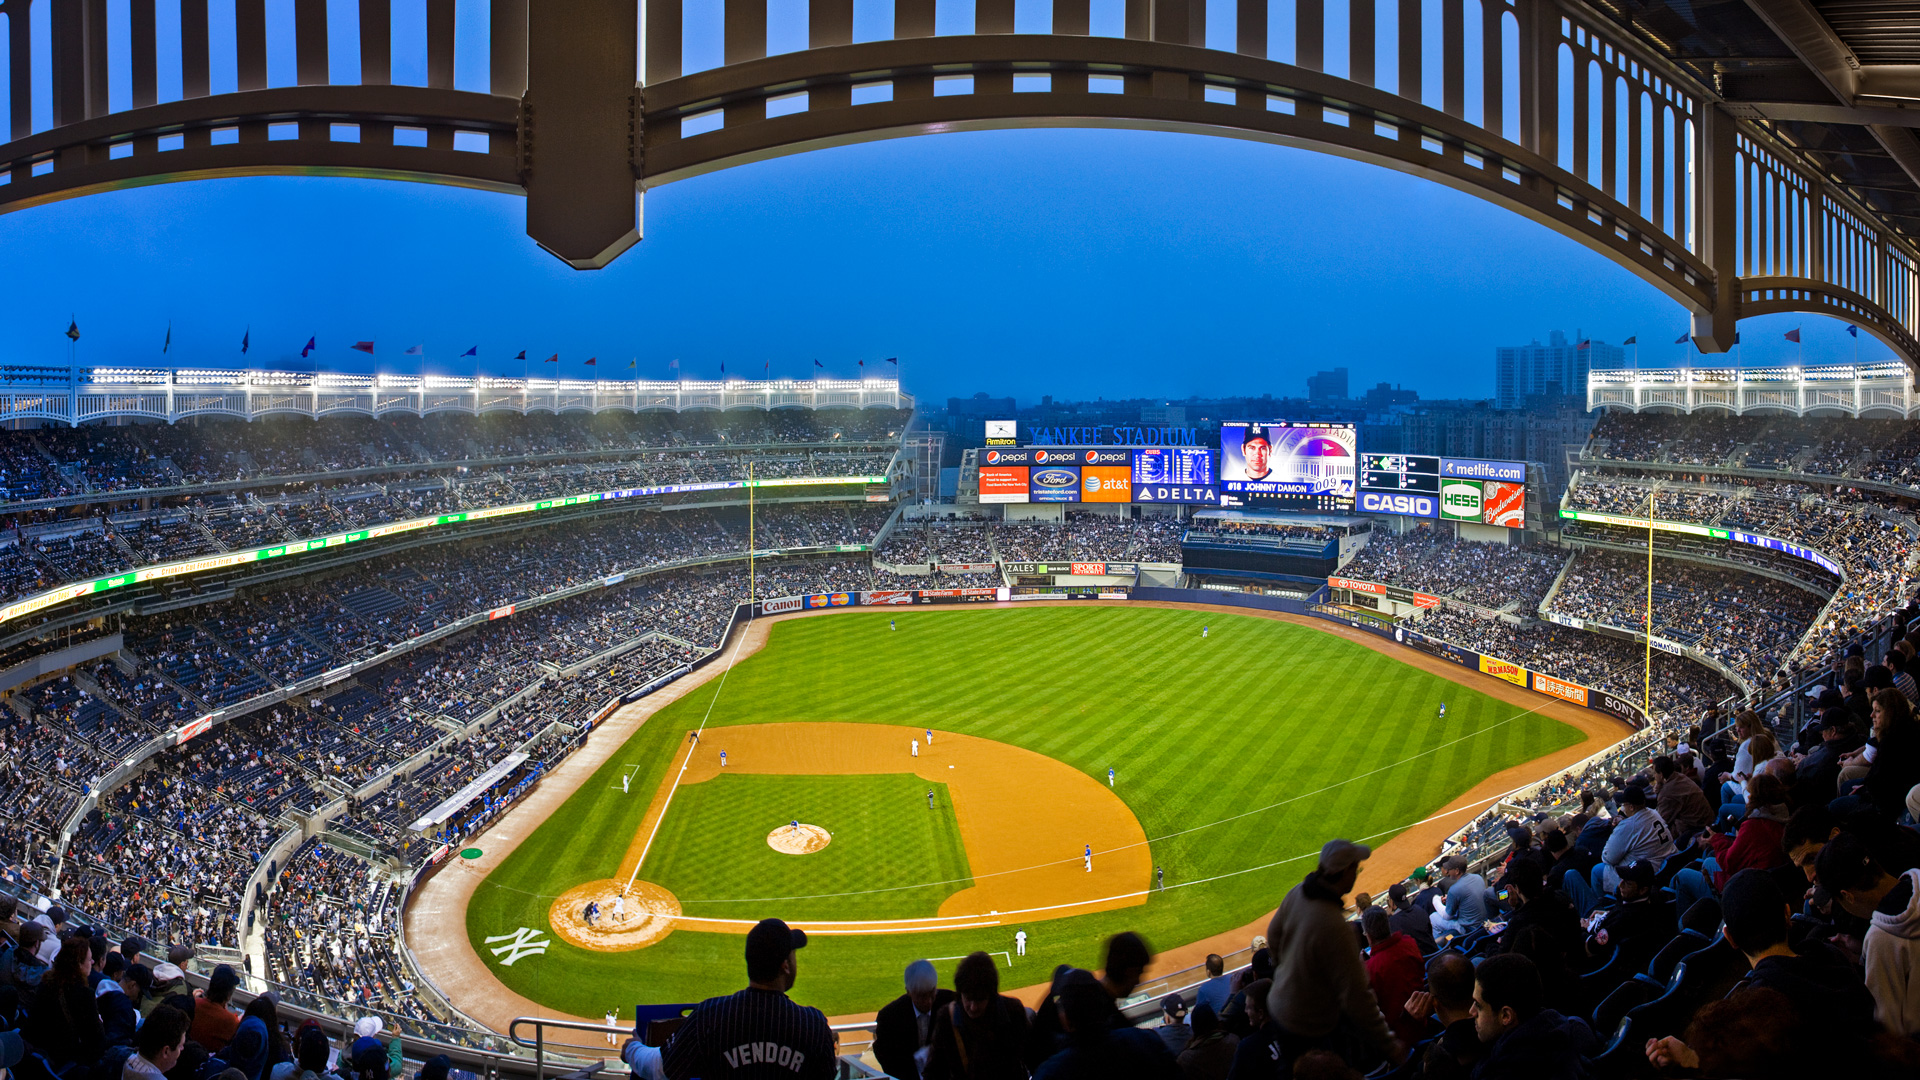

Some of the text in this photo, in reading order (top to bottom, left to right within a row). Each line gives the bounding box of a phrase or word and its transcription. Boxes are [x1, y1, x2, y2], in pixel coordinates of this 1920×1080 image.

[1028, 427, 1197, 446] YANKEE STADIUM
[1001, 453, 1027, 462] pepsi
[1049, 453, 1075, 461] pepsi
[1100, 453, 1126, 461] pepsi
[1456, 463, 1520, 479] metlife.com
[1043, 473, 1067, 484] Ford
[1103, 478, 1128, 489] at&t
[1308, 478, 1336, 491] 2009
[1158, 488, 1215, 500] DELTA
[1228, 482, 1307, 493] #18 JOHNNY DAMON
[1363, 494, 1432, 515] CASIO
[1444, 493, 1479, 508] HESS
[1484, 485, 1525, 523] Budweiser
[162, 566, 184, 575] Crinkle
[197, 560, 217, 569] French
[1349, 581, 1376, 592] TOYOTA
[764, 600, 801, 612] Canon
[1558, 616, 1572, 625] UTZ
[1650, 640, 1679, 654] KOMATSU
[1547, 680, 1584, 702] 読売新聞
[1605, 697, 1636, 719] SONY
[1653, 820, 1670, 845] 2
[484, 927, 550, 966] NY
[724, 1041, 805, 1073] VENDOR
